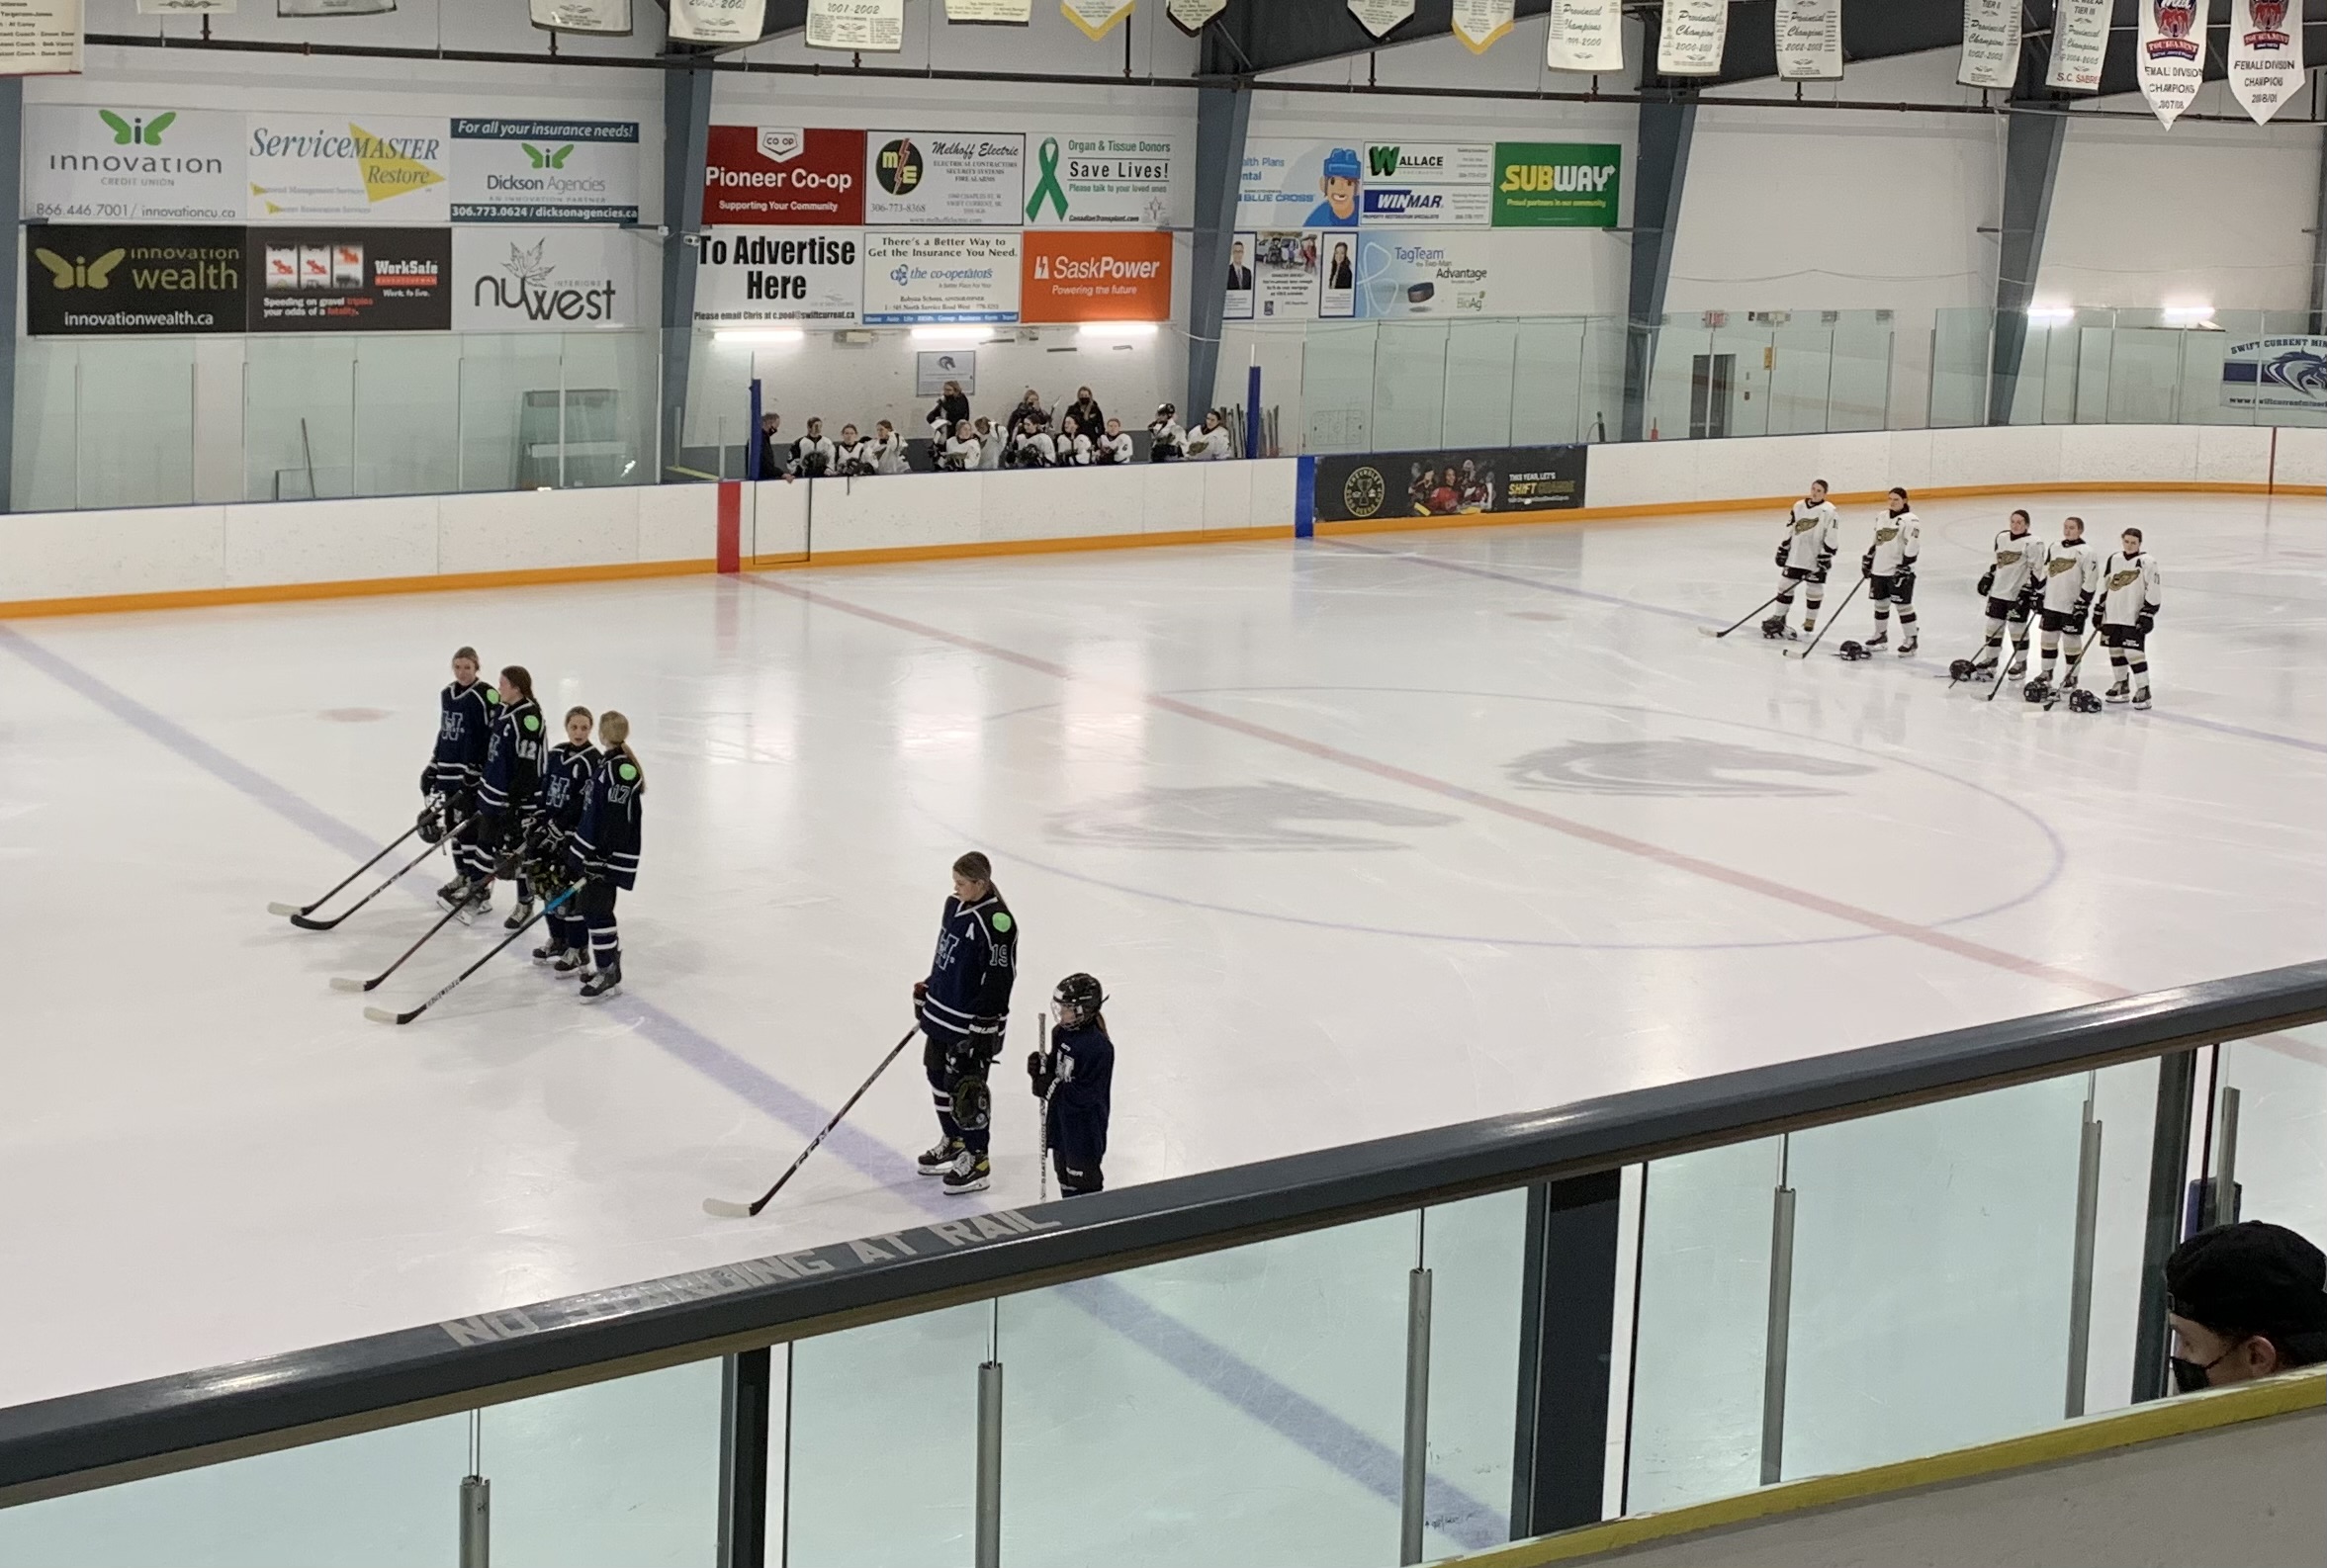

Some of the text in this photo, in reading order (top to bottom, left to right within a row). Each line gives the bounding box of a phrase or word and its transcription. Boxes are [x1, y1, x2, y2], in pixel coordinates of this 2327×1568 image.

[458, 120, 633, 138] For all your insurance needs!
[250, 128, 440, 160] ServiceMASTER
[932, 141, 1019, 159] Melhoff Electric
[1068, 139, 1170, 153] Organ & Tissue Donors
[50, 154, 223, 174] innovation
[1070, 161, 1168, 178] Save Lives!
[1242, 158, 1285, 167] alth Plans
[101, 177, 175, 187] CREDIT UNION
[367, 166, 431, 184] Restore
[706, 167, 851, 192] Pioneer Co-op
[1242, 172, 1262, 180] ntal
[1499, 165, 1615, 193] SUBWAY
[487, 175, 606, 192] Dickson Agencies
[1069, 184, 1091, 192] Please
[1116, 185, 1130, 194] your
[719, 200, 838, 213] Supporting Your Community
[1378, 195, 1442, 209] WINMAR
[37, 204, 235, 218] 866.446.7001 innovationcu.ca
[452, 206, 637, 220] 306.773.0624 dicksonagencies.ca
[699, 235, 855, 265] To Advertise
[882, 237, 919, 246] There's
[934, 238, 965, 246] Better
[969, 238, 990, 248] Way
[131, 248, 239, 260] innovation
[868, 248, 1018, 258] Get the Insurance You Need.
[1395, 247, 1444, 263] TagTeam
[375, 260, 438, 274] WorkSafe
[910, 267, 993, 281] the co-operators
[1054, 256, 1160, 279] SaskPower
[1436, 268, 1487, 281] Advantage
[133, 261, 238, 290] wealth
[747, 270, 806, 300] Here
[1052, 285, 1137, 296] Powering the future
[264, 298, 304, 308] Speeding
[65, 311, 214, 327] innovationwealth.ca
[264, 309, 282, 318] your
[694, 311, 719, 320] Please
[2231, 339, 2308, 354] SWIFT CURRENT
[1508, 482, 1537, 495] SHIFT
[519, 740, 537, 760] 12
[608, 784, 630, 804] 17
[965, 922, 975, 940] A
[989, 944, 1008, 967] 19
[439, 1309, 540, 1346] NO
[853, 1231, 918, 1263] AT
[933, 1207, 1061, 1248] RAIL
